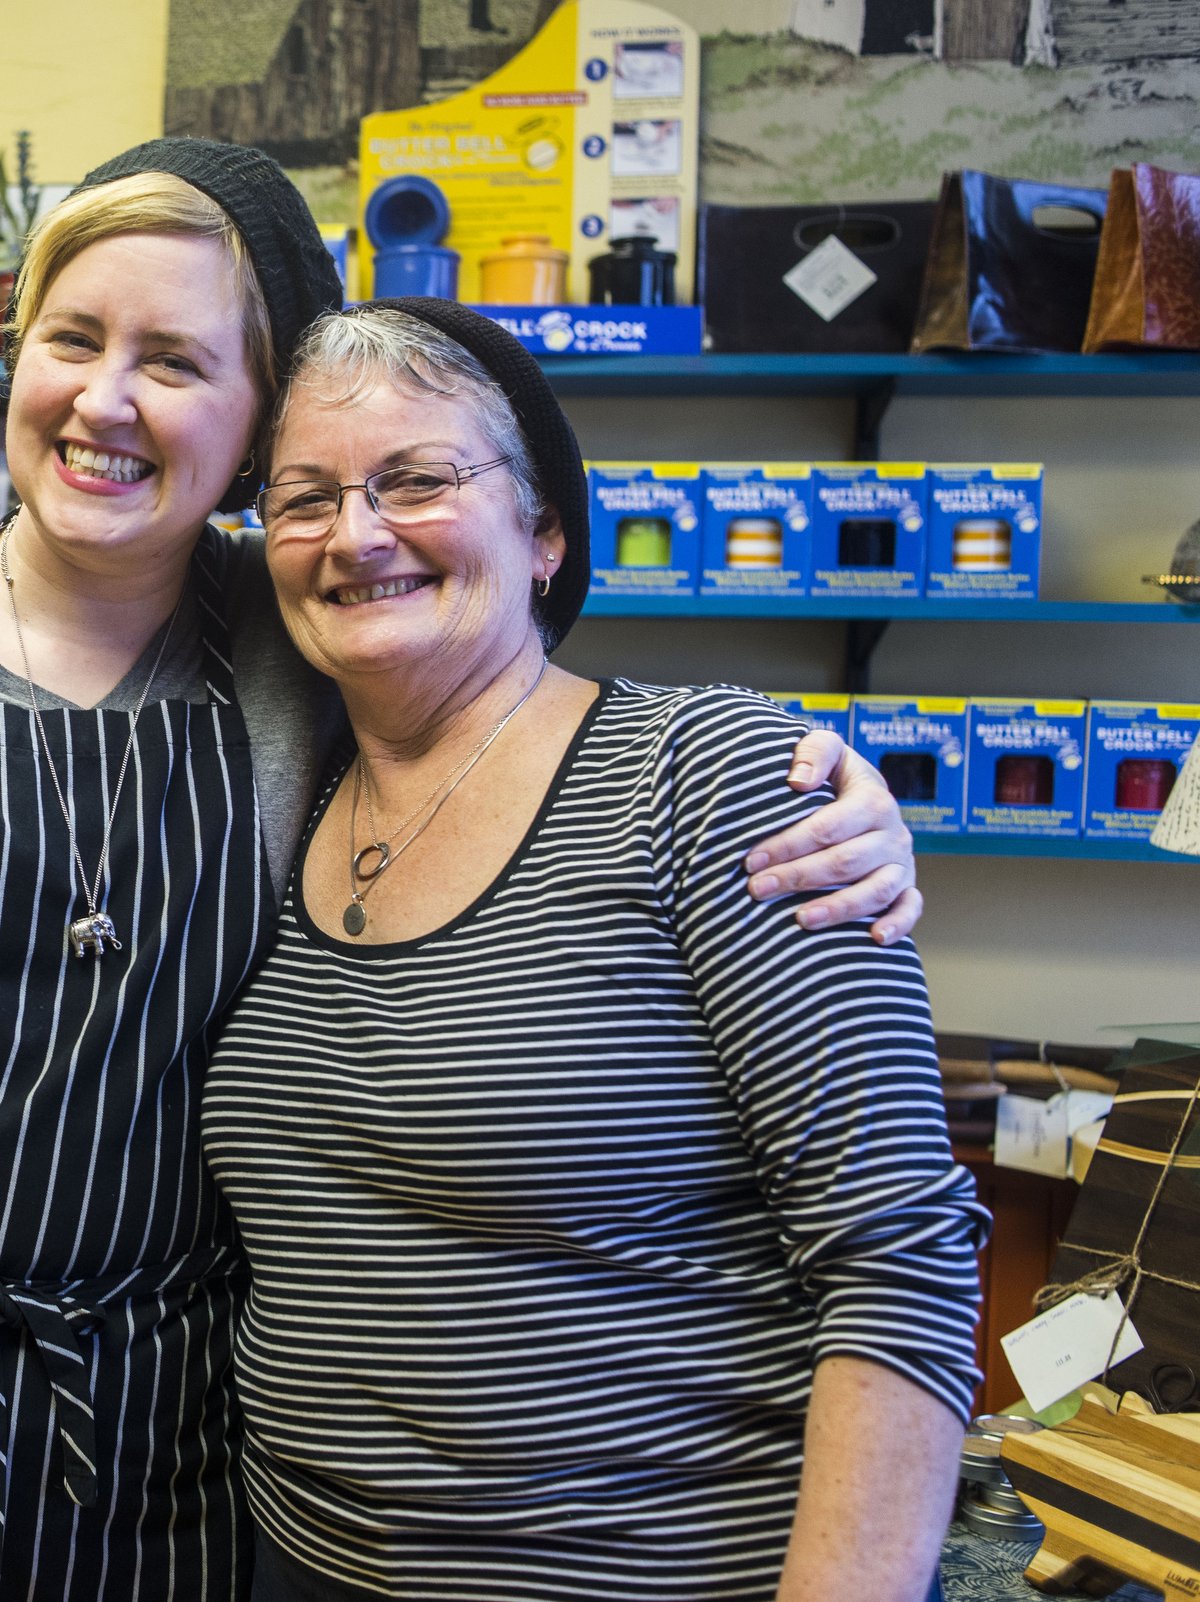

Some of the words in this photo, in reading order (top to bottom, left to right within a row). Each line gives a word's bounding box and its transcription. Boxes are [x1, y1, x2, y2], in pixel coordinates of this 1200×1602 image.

[369, 136, 450, 154] BUTTER
[456, 135, 507, 151] BELL
[379, 153, 453, 170] CROCK
[495, 317, 535, 338] ELL
[573, 319, 648, 341] CROCK
[597, 487, 649, 501] BUTTER
[706, 487, 760, 501] BUTTER
[819, 487, 873, 501] BUTTER
[933, 489, 988, 503] BUTTER
[859, 720, 914, 735] BUTTER
[917, 722, 951, 736] BELL
[976, 723, 1031, 738] BUTTER
[1035, 725, 1070, 738] BELL
[1097, 727, 1153, 740] BUTTER
[1157, 729, 1192, 742] BELL
[866, 733, 915, 746] CROCK
[983, 737, 1033, 749] CROCK
[1104, 740, 1155, 751] CROCK
